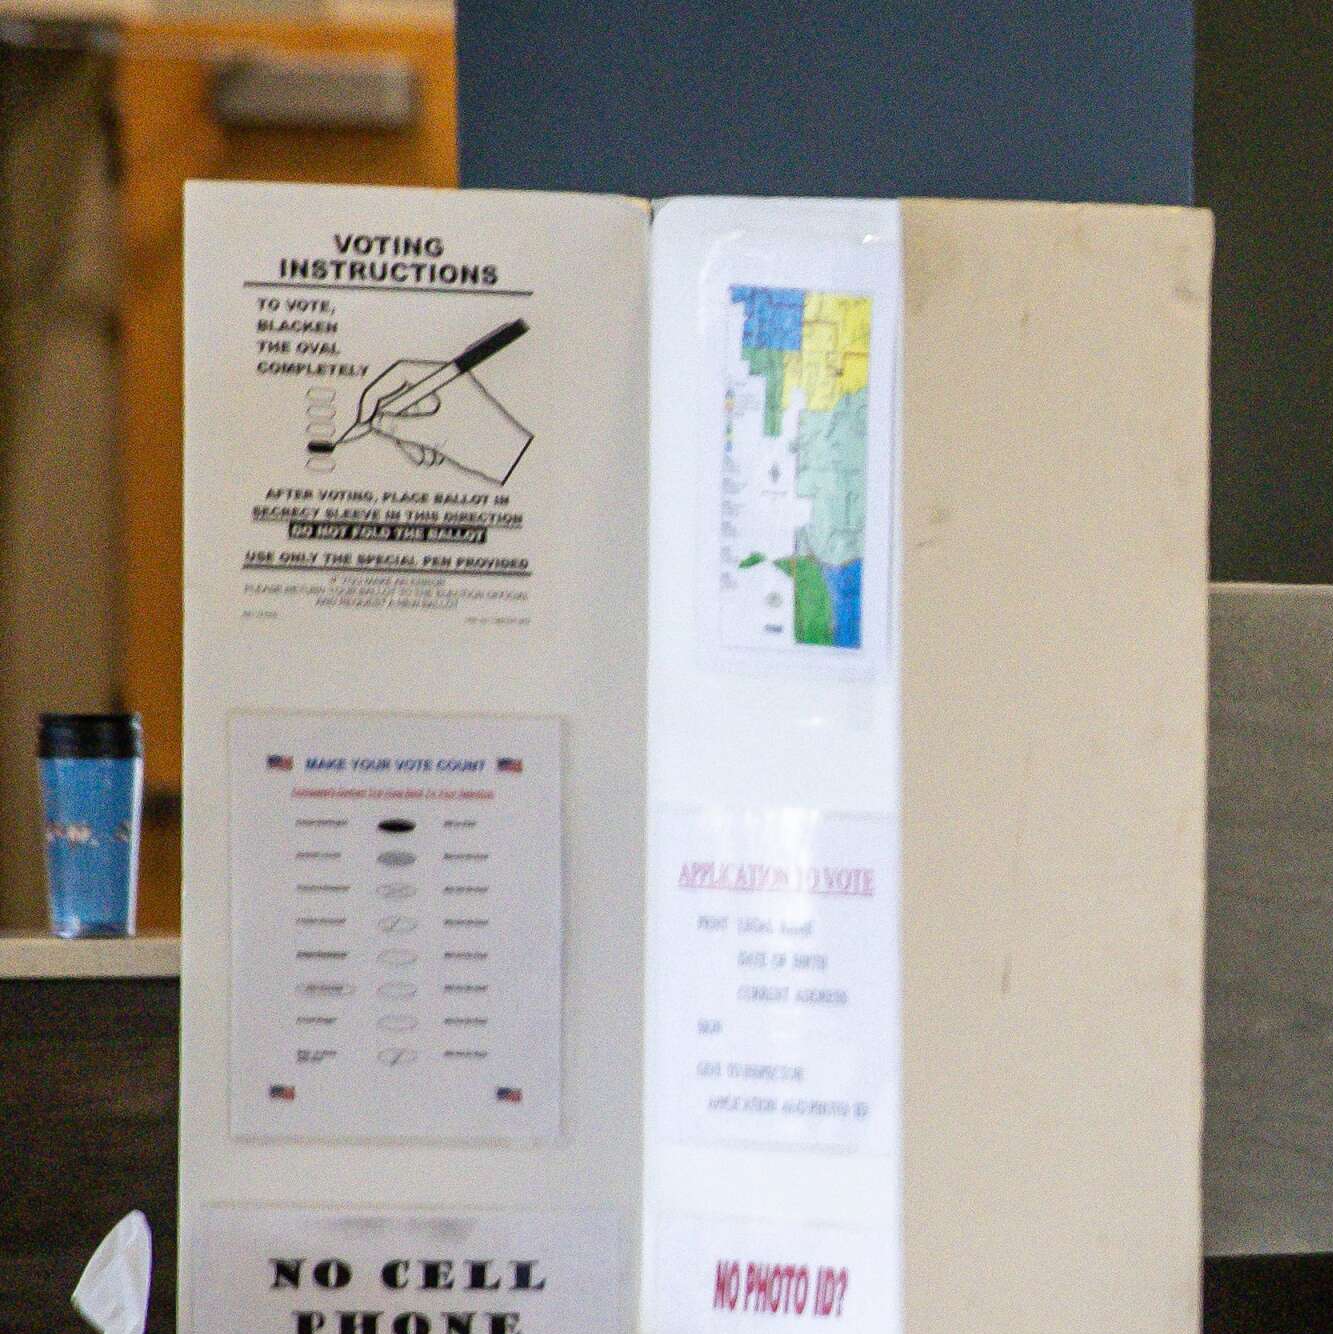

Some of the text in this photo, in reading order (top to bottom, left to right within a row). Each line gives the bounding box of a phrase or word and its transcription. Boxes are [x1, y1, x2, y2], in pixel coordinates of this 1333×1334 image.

[334, 233, 445, 258] VOTING
[280, 258, 499, 286] INSTRUCTIONS
[258, 298, 280, 311] TO
[257, 319, 338, 333] BLACKEN
[258, 340, 340, 354] THE OVAL
[266, 487, 313, 501] AFTER
[382, 491, 429, 505] PLACE
[433, 493, 490, 507] BALLOT
[494, 495, 511, 506] IN
[406, 510, 439, 522] THIS
[443, 511, 523, 525] DIRECTION
[245, 550, 529, 570] USE ONLY THE SPECIAL PEN PROVIDED
[268, 1257, 547, 1291] NO CELL
[713, 1260, 849, 1317] NO PHOTO ID?
